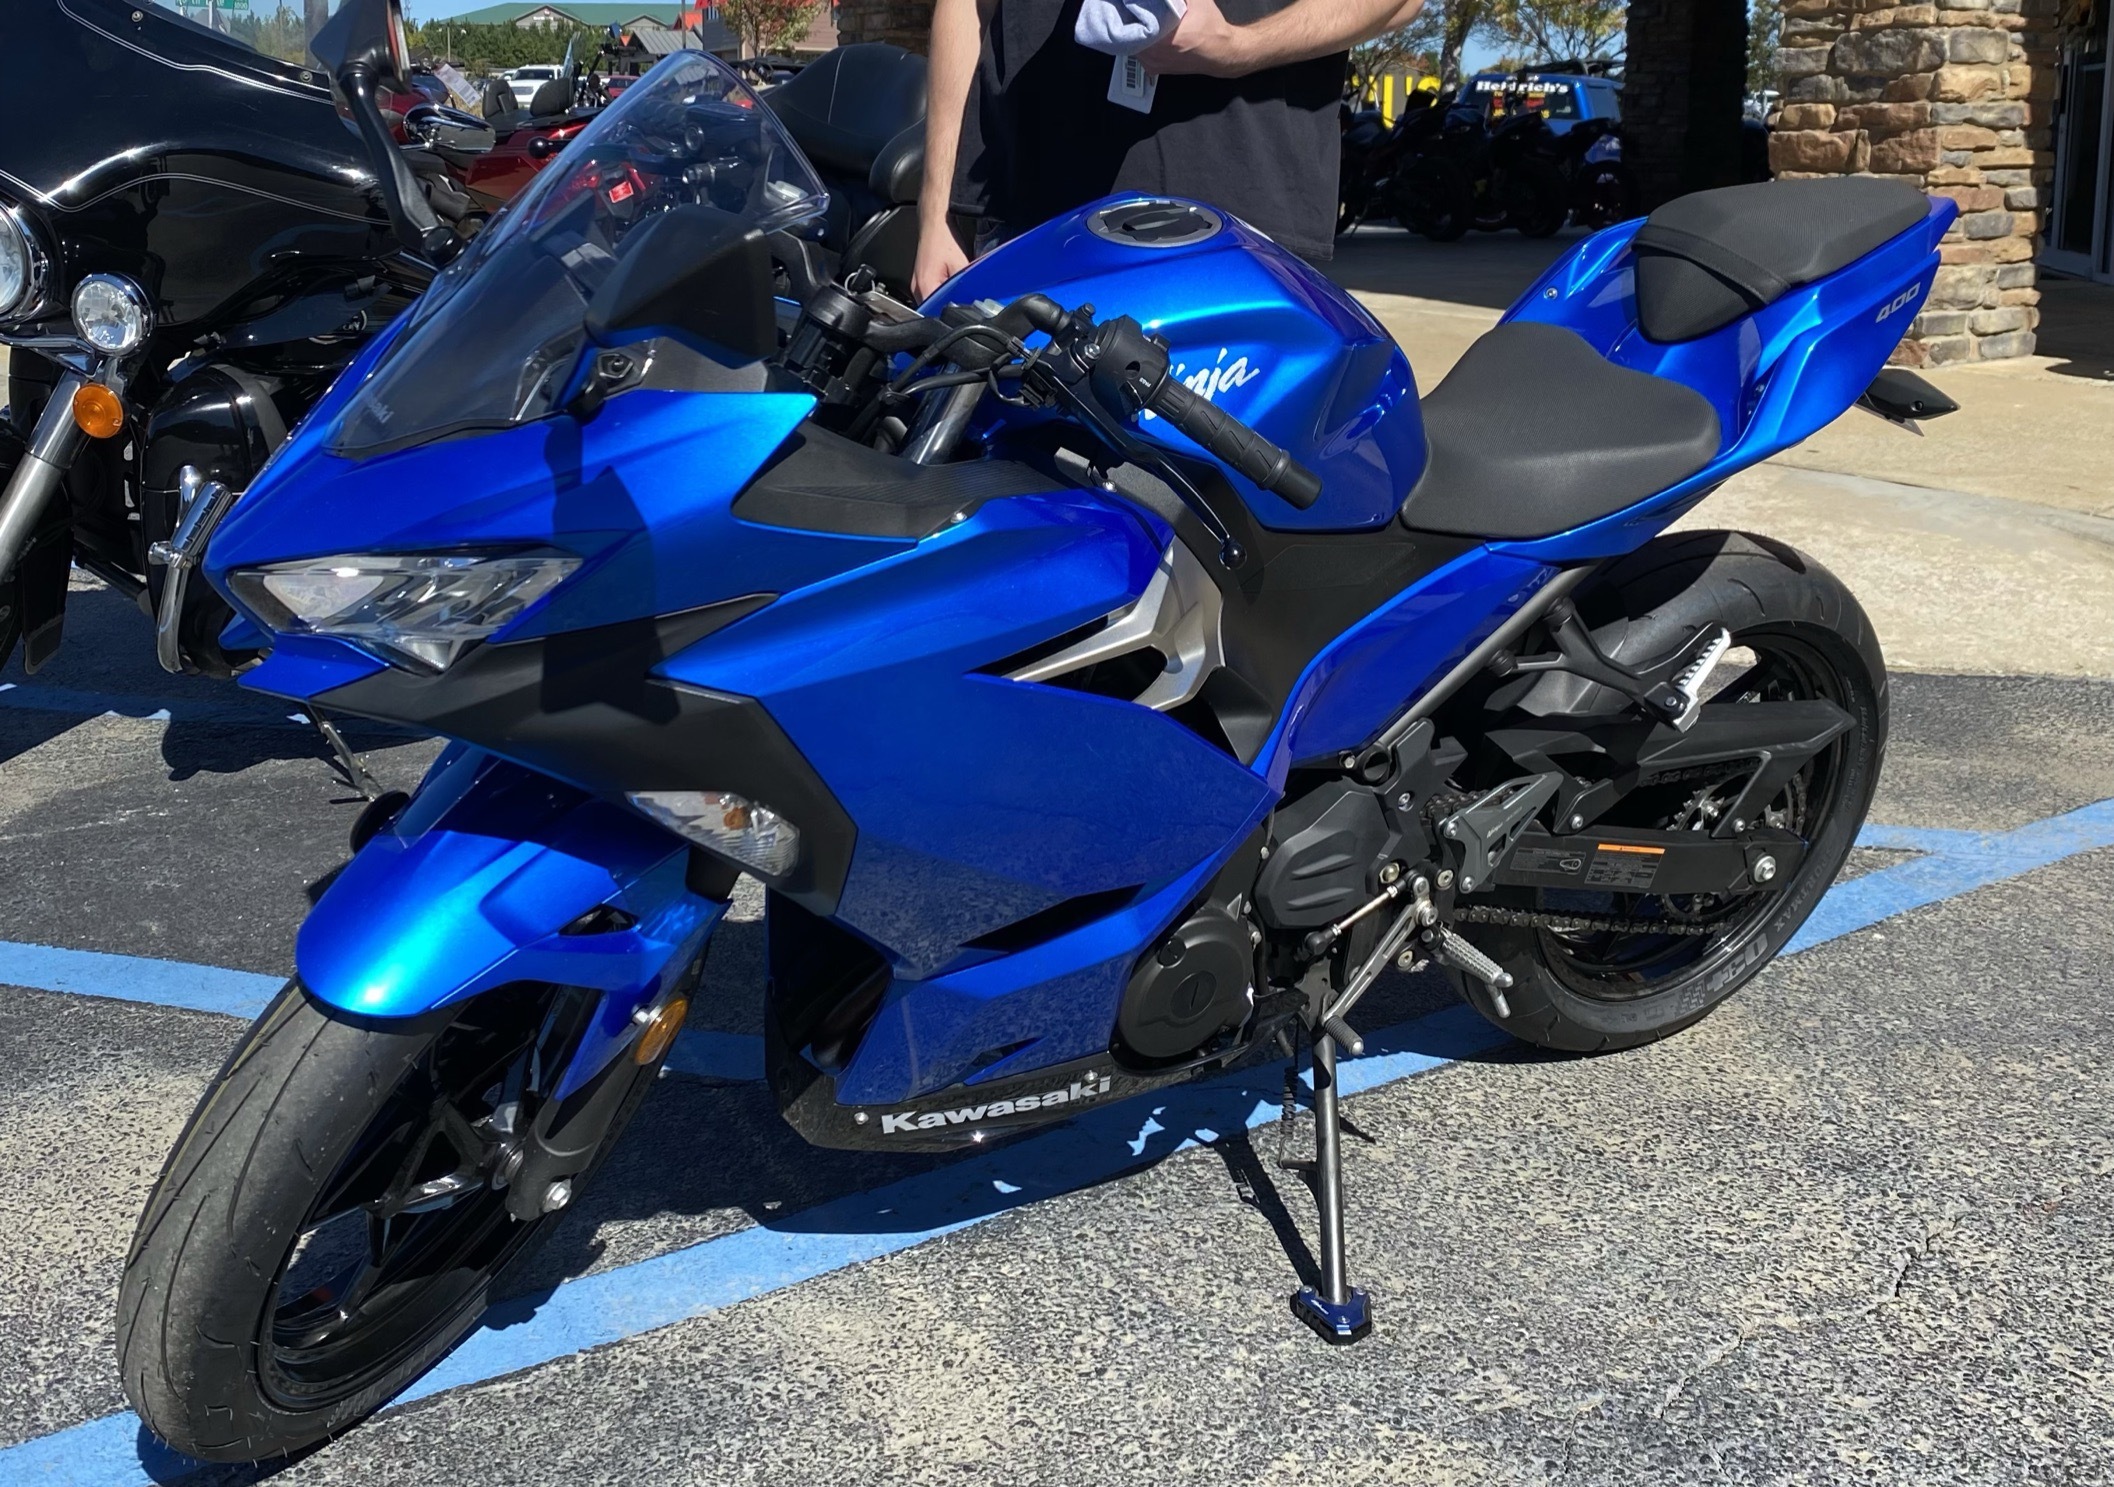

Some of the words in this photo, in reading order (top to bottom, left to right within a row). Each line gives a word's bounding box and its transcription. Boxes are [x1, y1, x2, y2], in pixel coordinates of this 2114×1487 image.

[1875, 281, 1921, 324] 400
[1138, 347, 1261, 421] nja
[880, 1075, 1112, 1134] Kawasaki
